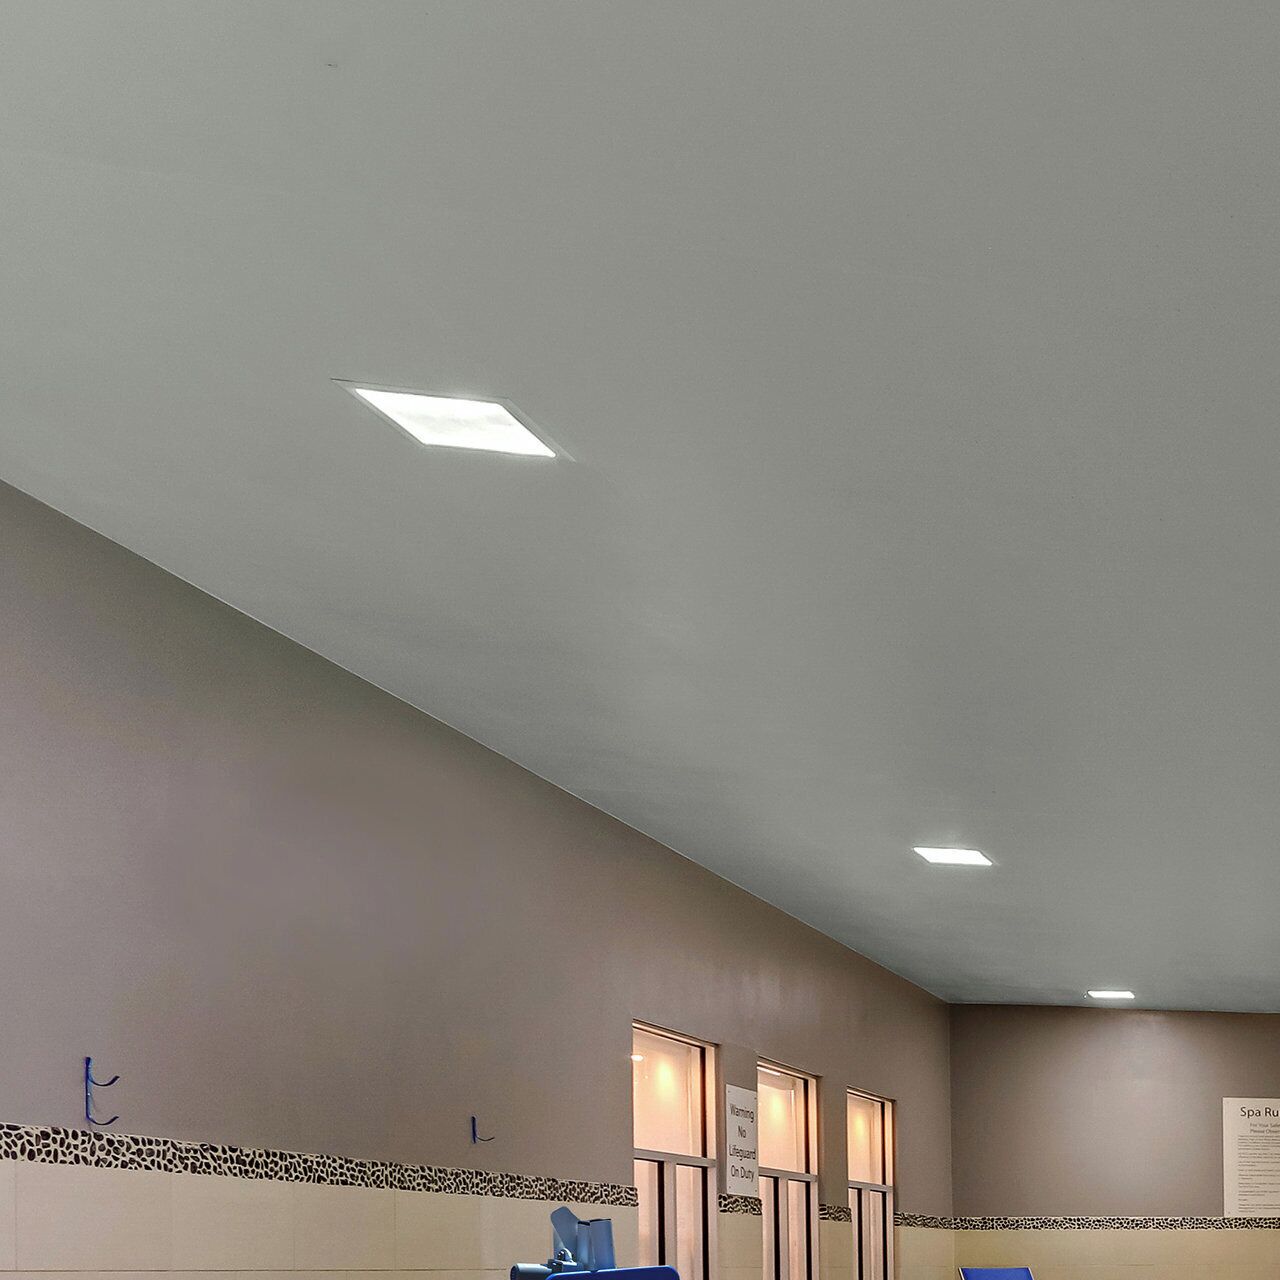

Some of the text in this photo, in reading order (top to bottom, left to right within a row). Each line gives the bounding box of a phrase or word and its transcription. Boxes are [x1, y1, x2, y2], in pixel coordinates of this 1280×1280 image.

[730, 1103, 754, 1123] Warning
[1240, 1106, 1261, 1118] Spa
[737, 1125, 746, 1138] No
[729, 1144, 756, 1161] Lifeguard
[731, 1164, 754, 1182] On Duty
